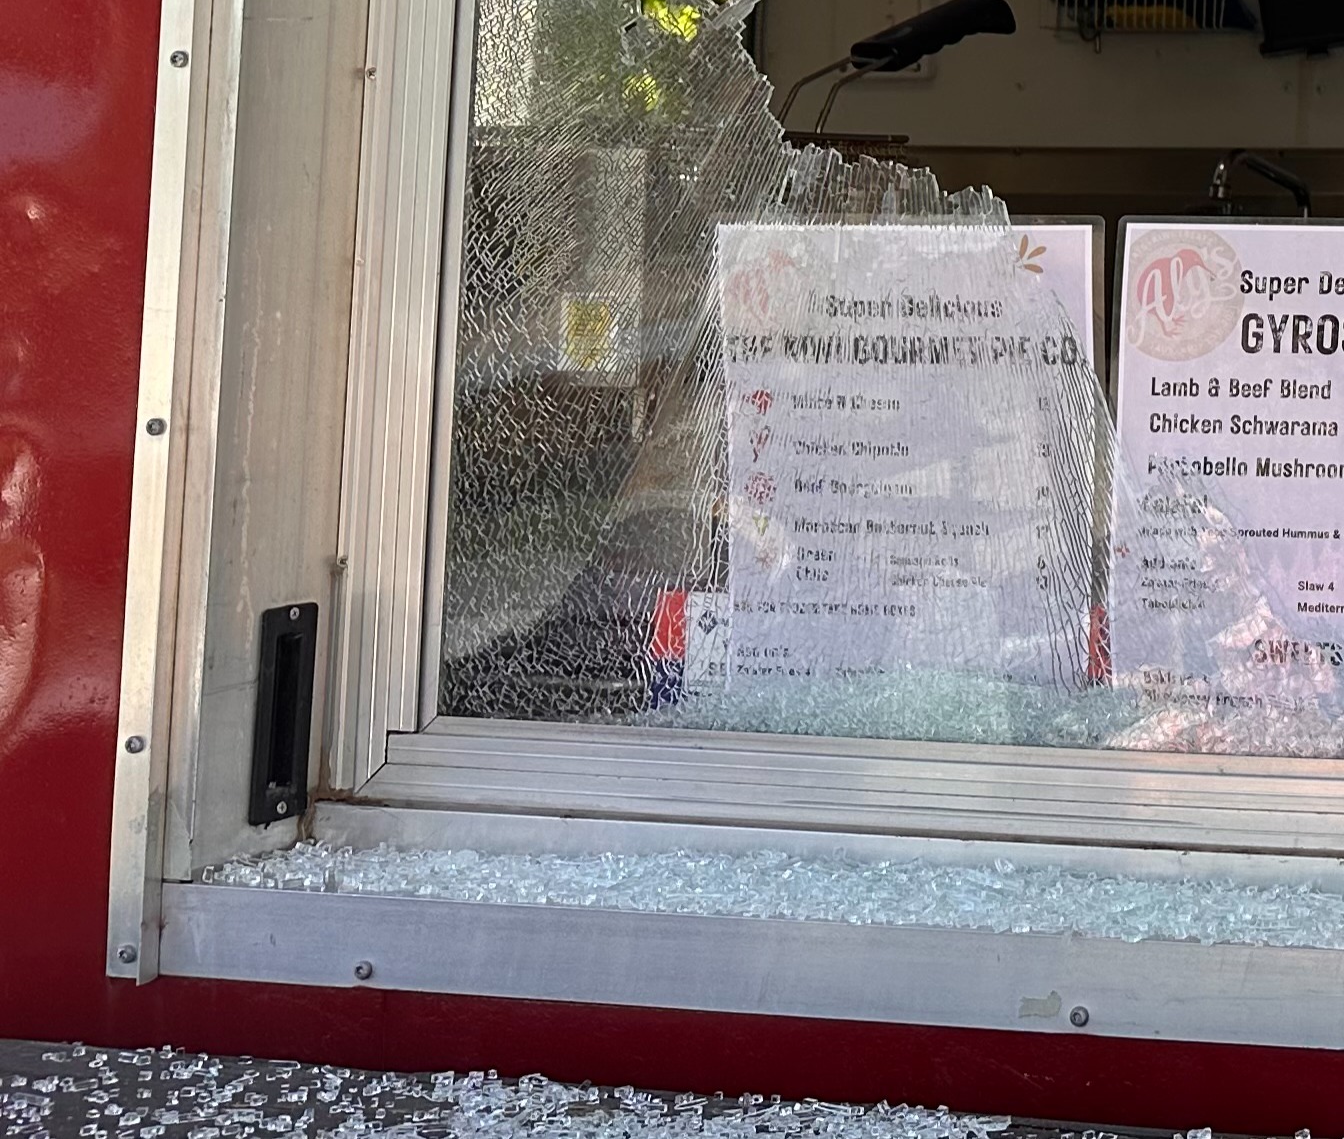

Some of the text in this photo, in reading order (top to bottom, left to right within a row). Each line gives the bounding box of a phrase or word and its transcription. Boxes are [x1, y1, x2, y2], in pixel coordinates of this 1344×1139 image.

[1240, 270, 1310, 302] Super
[826, 294, 1003, 323] Super Delicious
[1151, 377, 1200, 397] Lamb
[1208, 377, 1221, 398] &
[1229, 378, 1274, 399] Beef
[1280, 379, 1333, 400] Blend
[1150, 412, 1223, 435] Chicken
[1230, 414, 1339, 437] Schwarama
[1231, 527, 1279, 541] Sprouted
[1282, 529, 1330, 540] Hummus
[1333, 529, 1341, 540] &
[1298, 580, 1325, 592] Slaw
[1327, 581, 1335, 592] 4
